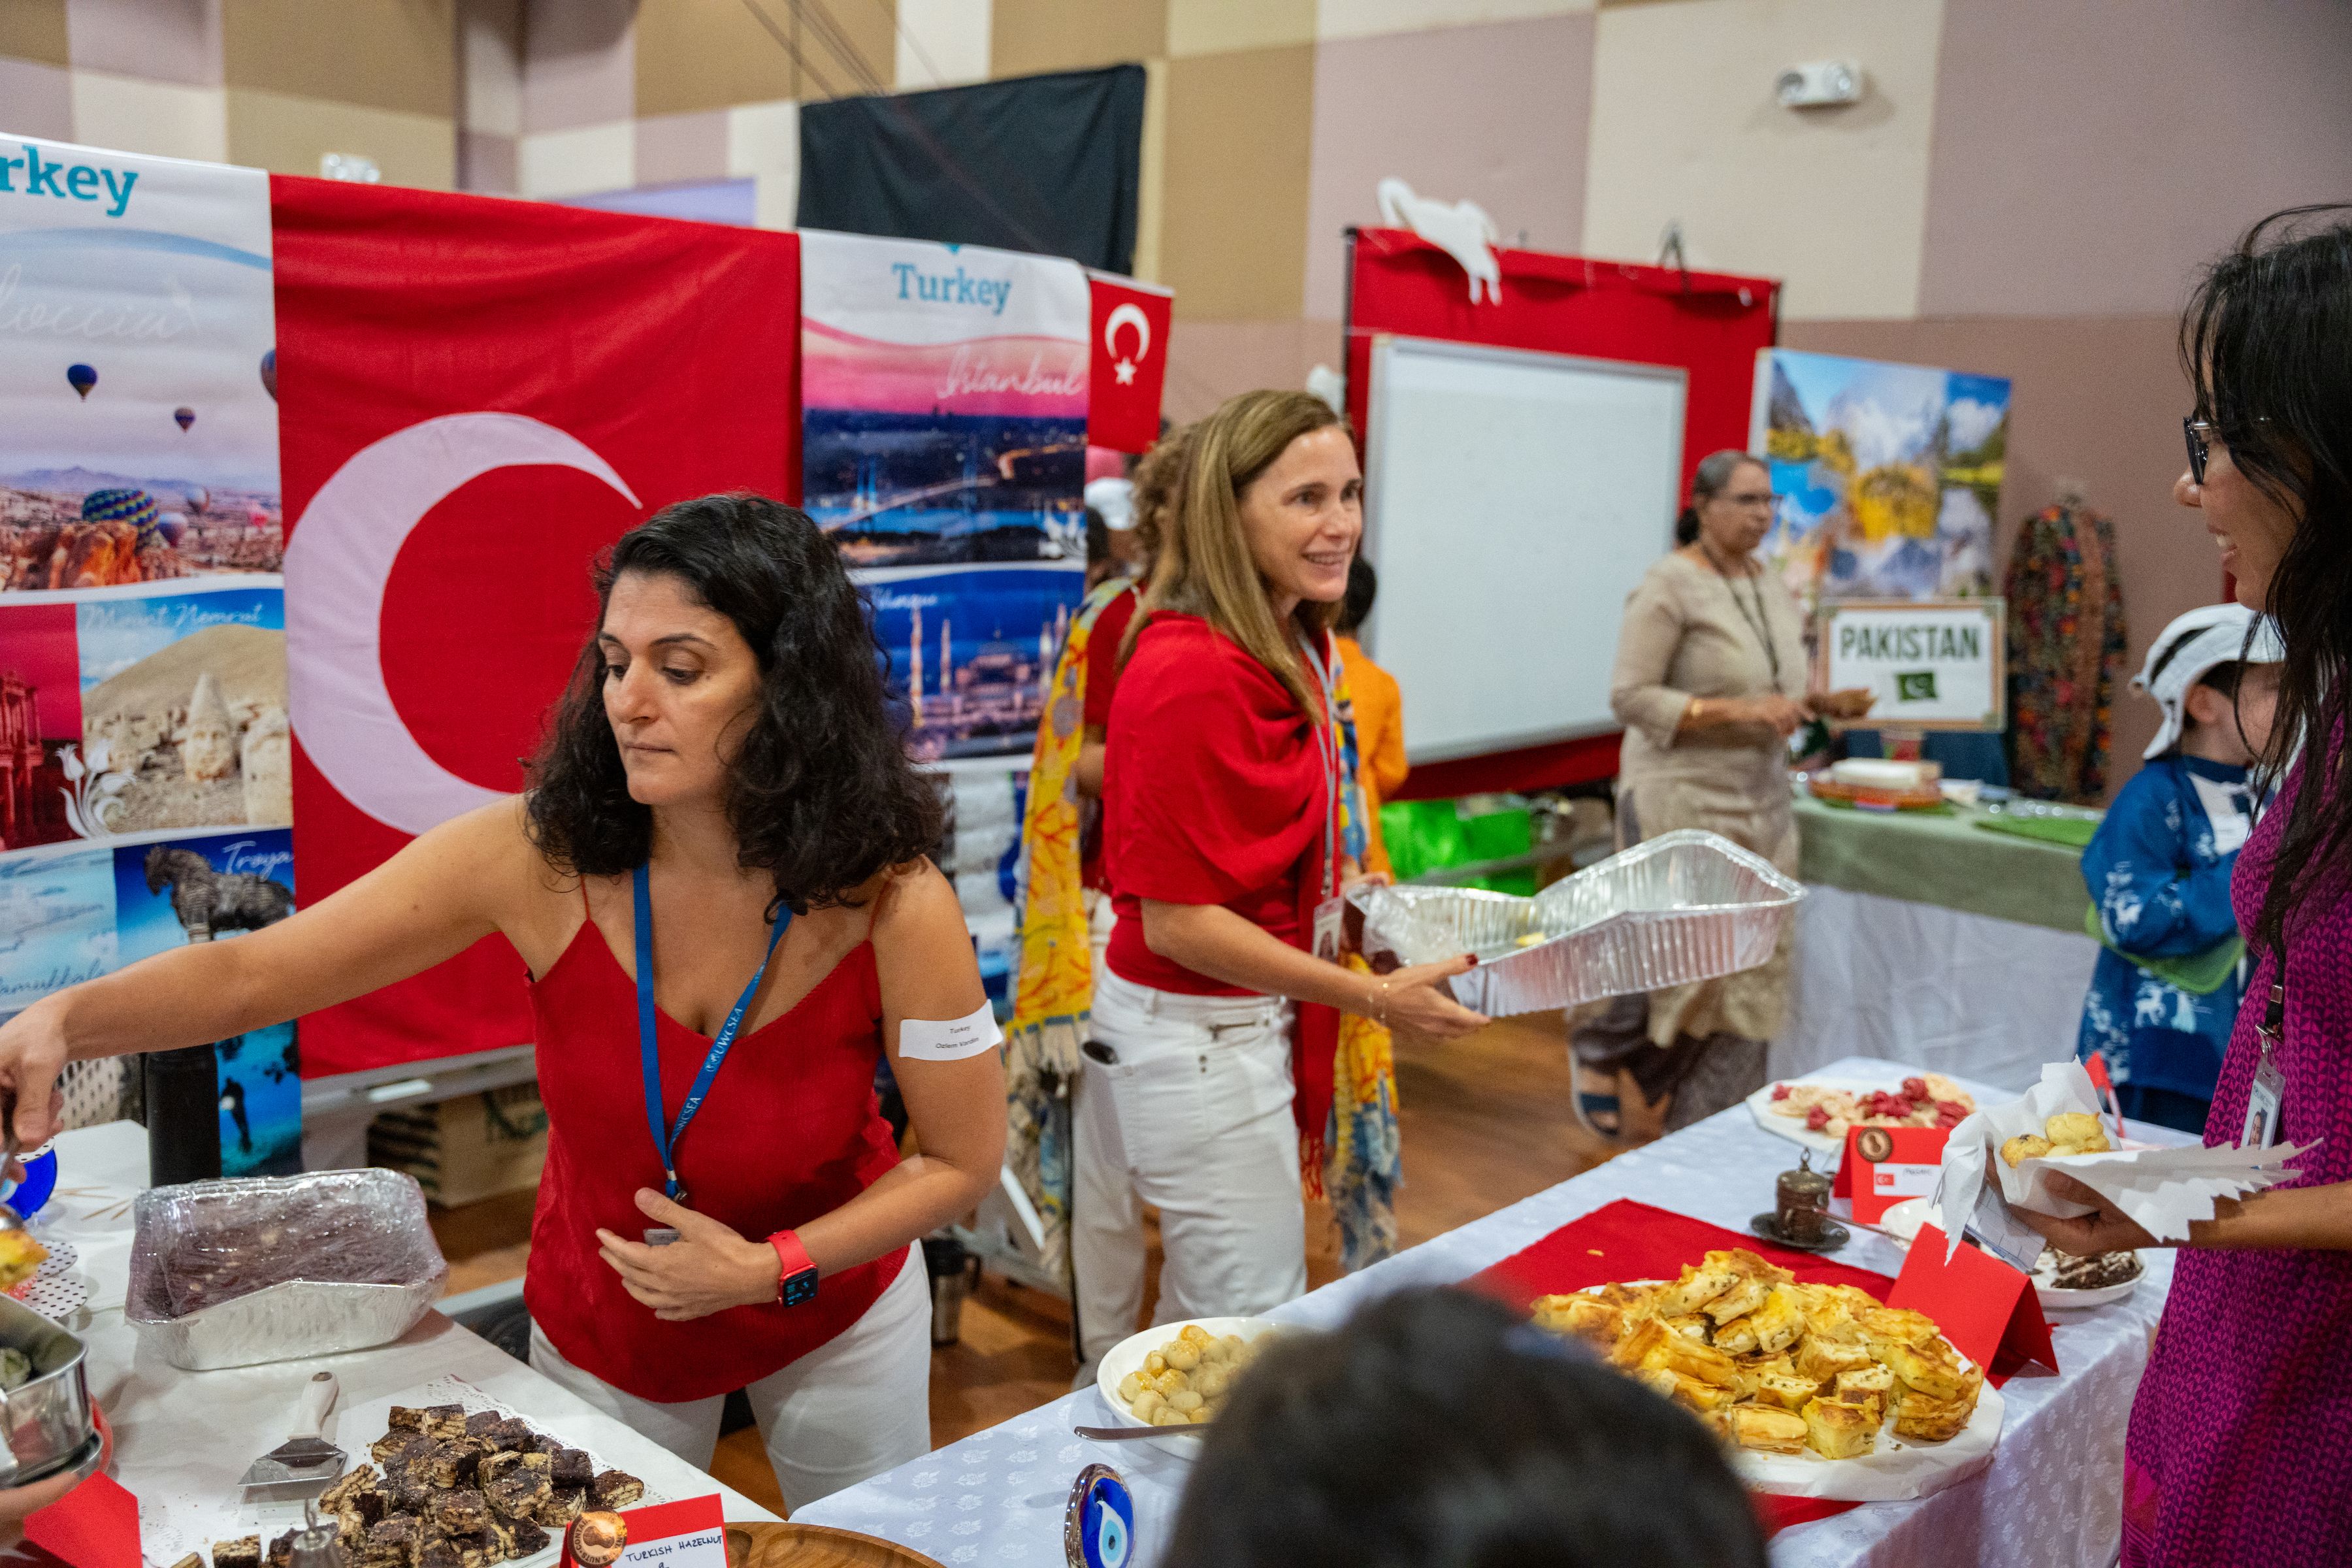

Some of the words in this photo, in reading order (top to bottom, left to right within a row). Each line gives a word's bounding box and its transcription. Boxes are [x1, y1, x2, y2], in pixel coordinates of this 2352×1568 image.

[0, 144, 139, 218] rkey
[890, 263, 1012, 315] Turkey
[1840, 625, 1980, 659] PAKISTAN
[222, 840, 294, 883] Troya
[625, 1545, 673, 1562] TURKISH
[678, 1535, 723, 1550] HAZELNUT
